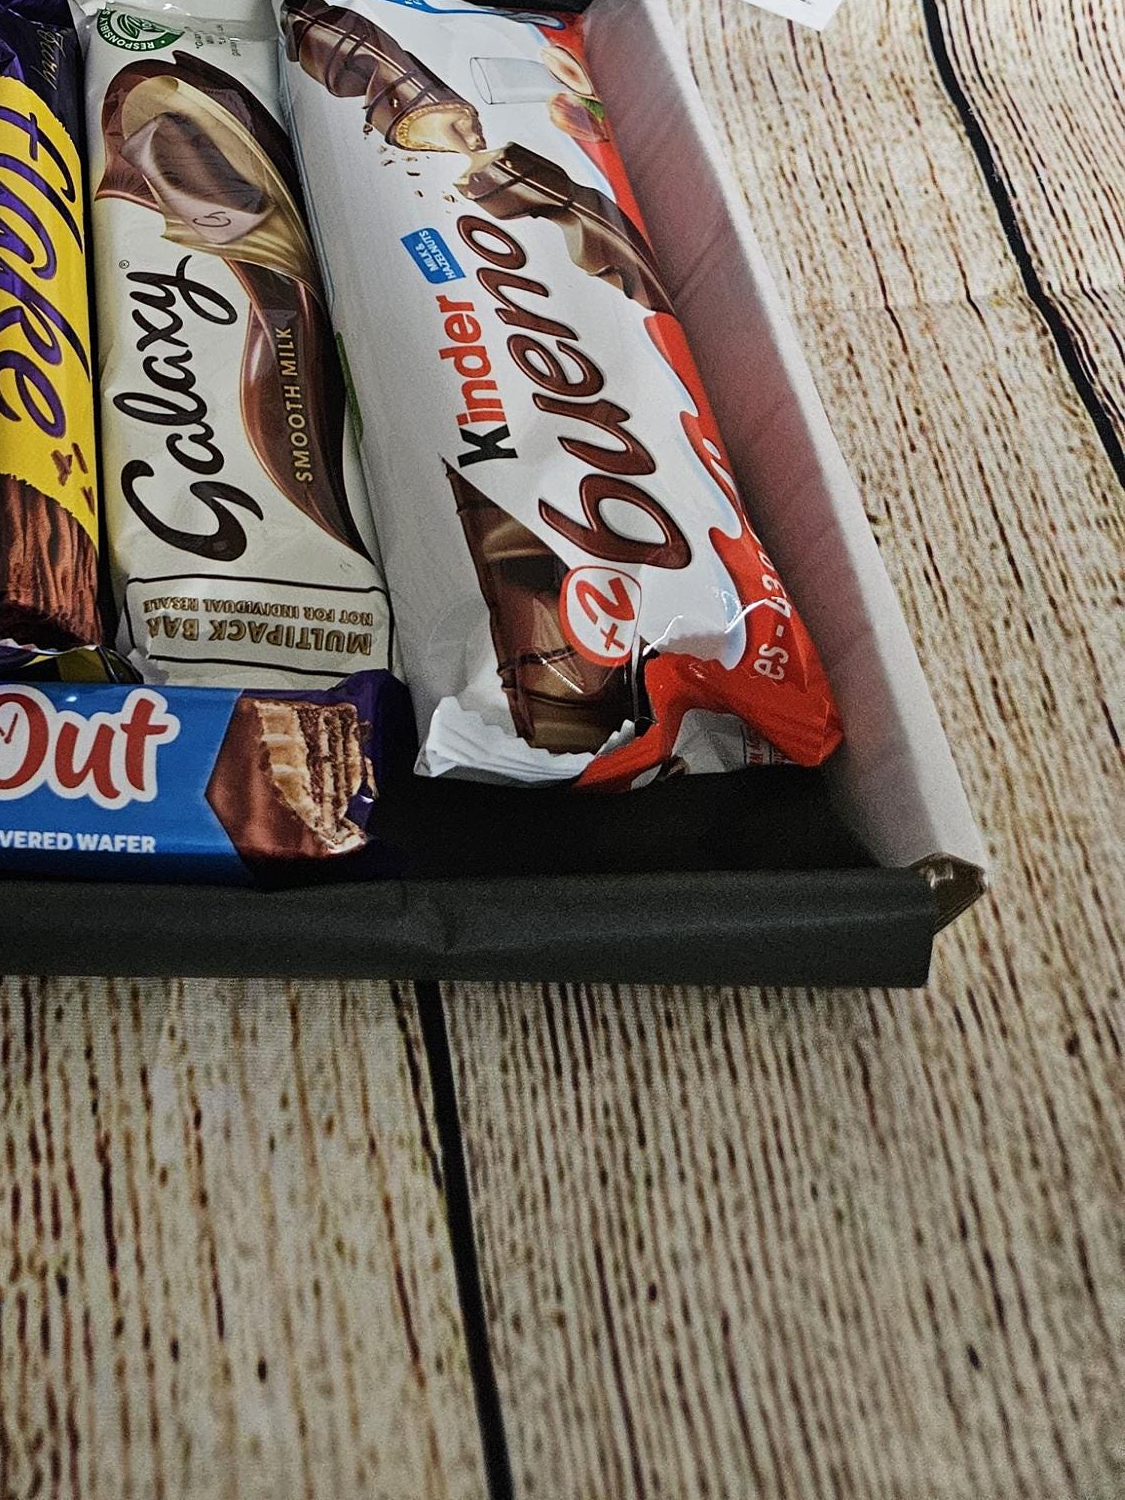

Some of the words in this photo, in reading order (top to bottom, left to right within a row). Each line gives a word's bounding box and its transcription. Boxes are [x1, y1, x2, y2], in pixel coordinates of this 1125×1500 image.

[418, 229, 457, 280] HAZELNUTS
[419, 249, 440, 272] MILK
[275, 327, 300, 377] MILK
[436, 294, 518, 468] Kinder
[456, 214, 693, 571] bueno
[112, 255, 264, 562] Galaxy
[287, 385, 314, 483] SMOOTH
[143, 596, 199, 613] RESALE
[203, 599, 300, 619] INDIVIDUAL
[303, 606, 336, 622] FOR
[338, 610, 373, 626] NOT
[209, 618, 373, 656] MULTIPACK
[76, 833, 156, 854] WAFER
